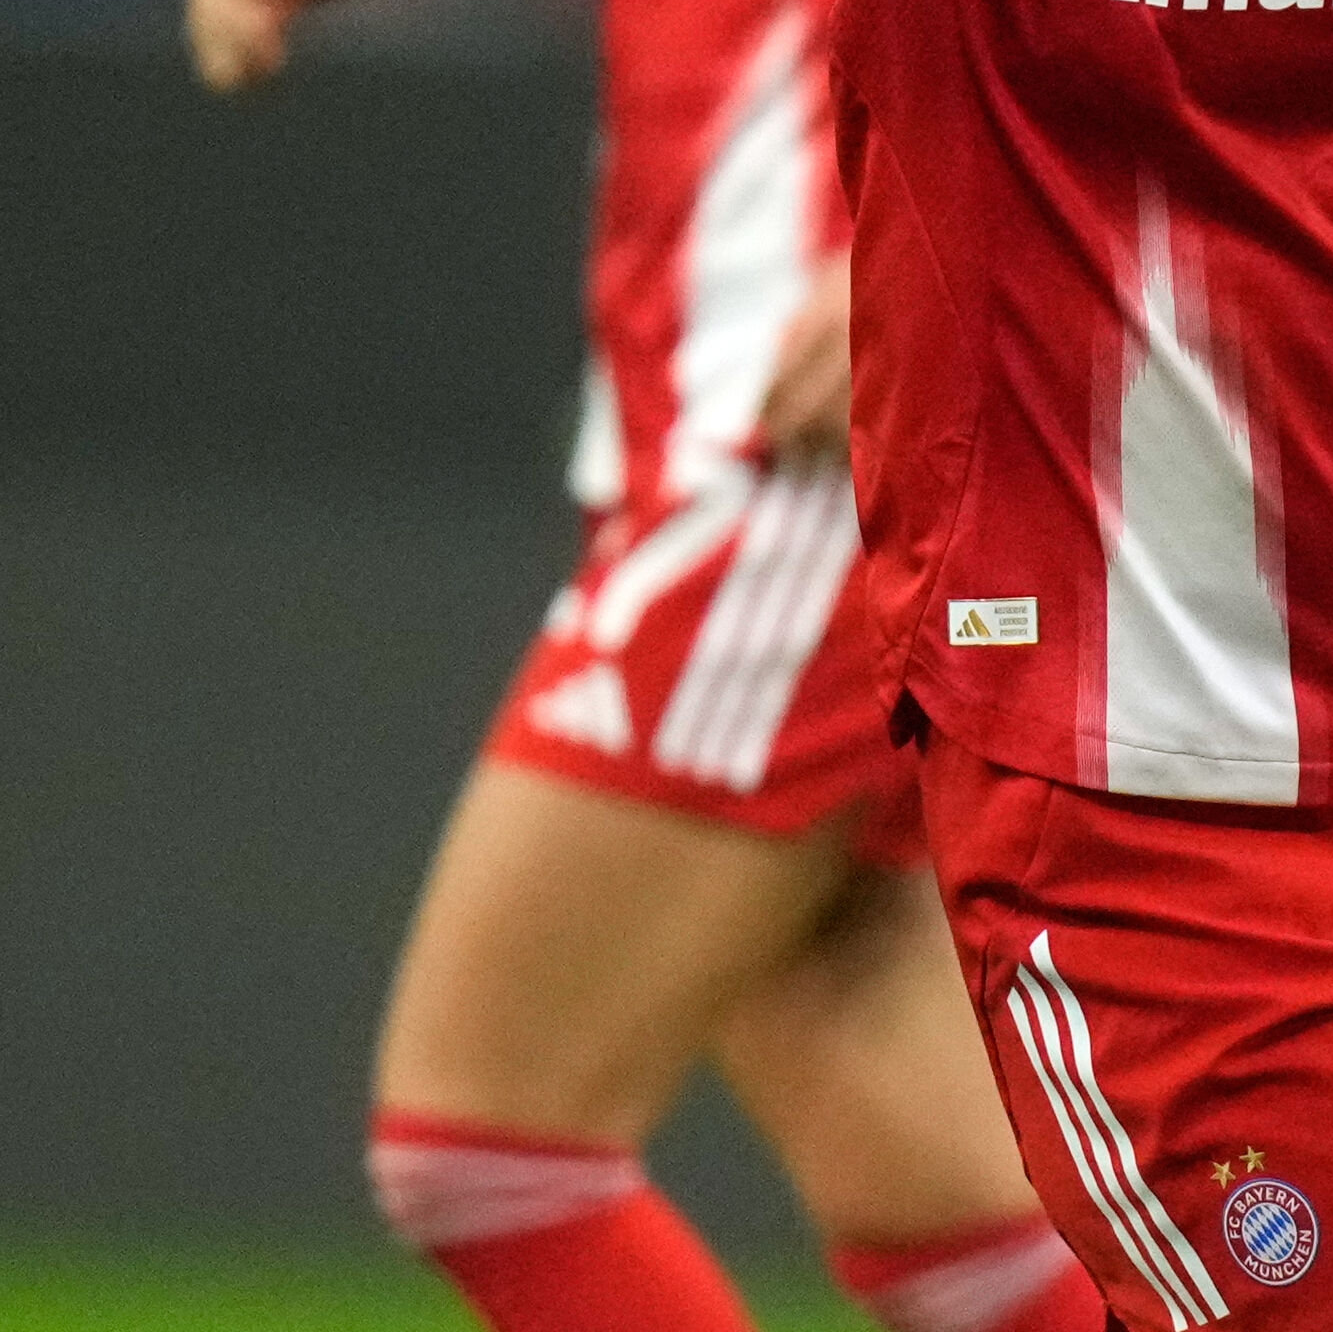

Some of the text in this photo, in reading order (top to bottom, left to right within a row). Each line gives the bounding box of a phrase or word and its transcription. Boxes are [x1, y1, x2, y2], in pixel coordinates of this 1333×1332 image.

[1229, 1187, 1300, 1239] FC BAYERN
[1244, 1230, 1312, 1279] MÜNCHEN
